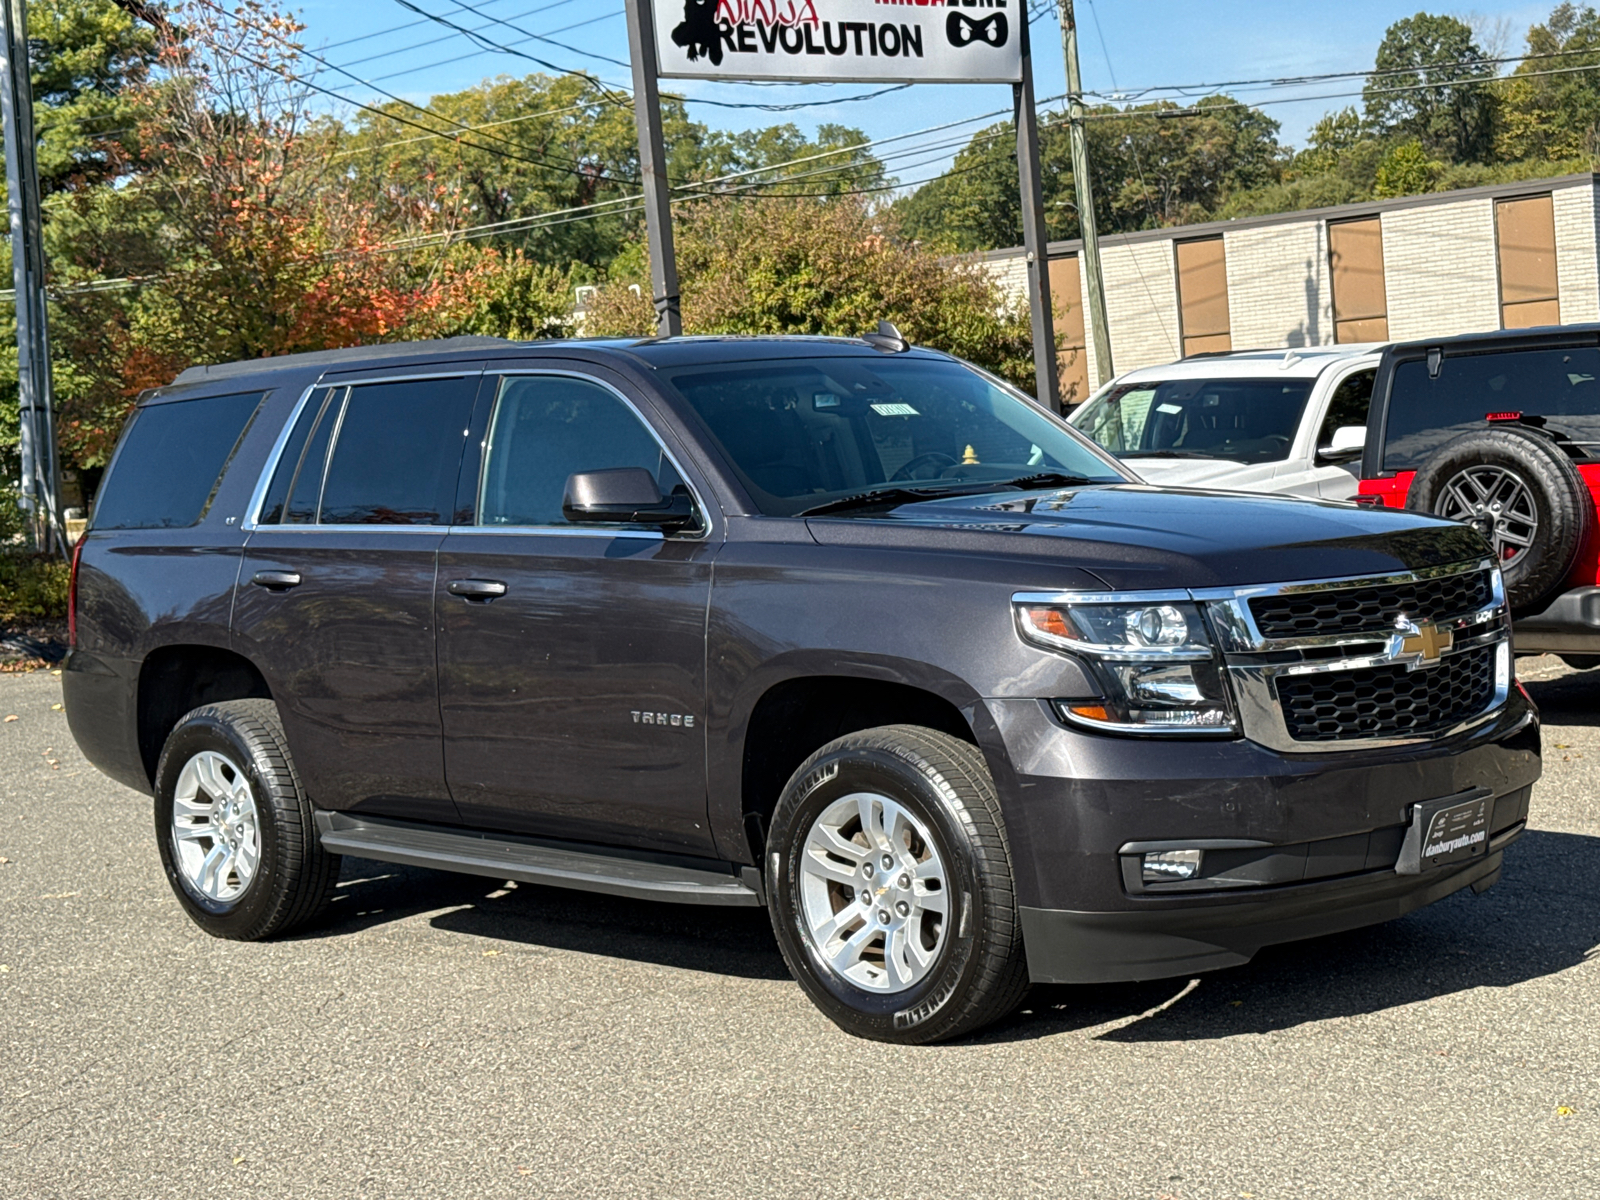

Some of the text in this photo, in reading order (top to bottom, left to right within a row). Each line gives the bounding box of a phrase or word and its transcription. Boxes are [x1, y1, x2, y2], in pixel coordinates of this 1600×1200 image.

[718, 18, 924, 57] REVOLUTION
[630, 710, 695, 728] TAHOE
[1425, 830, 1485, 857] danburyauto.com
